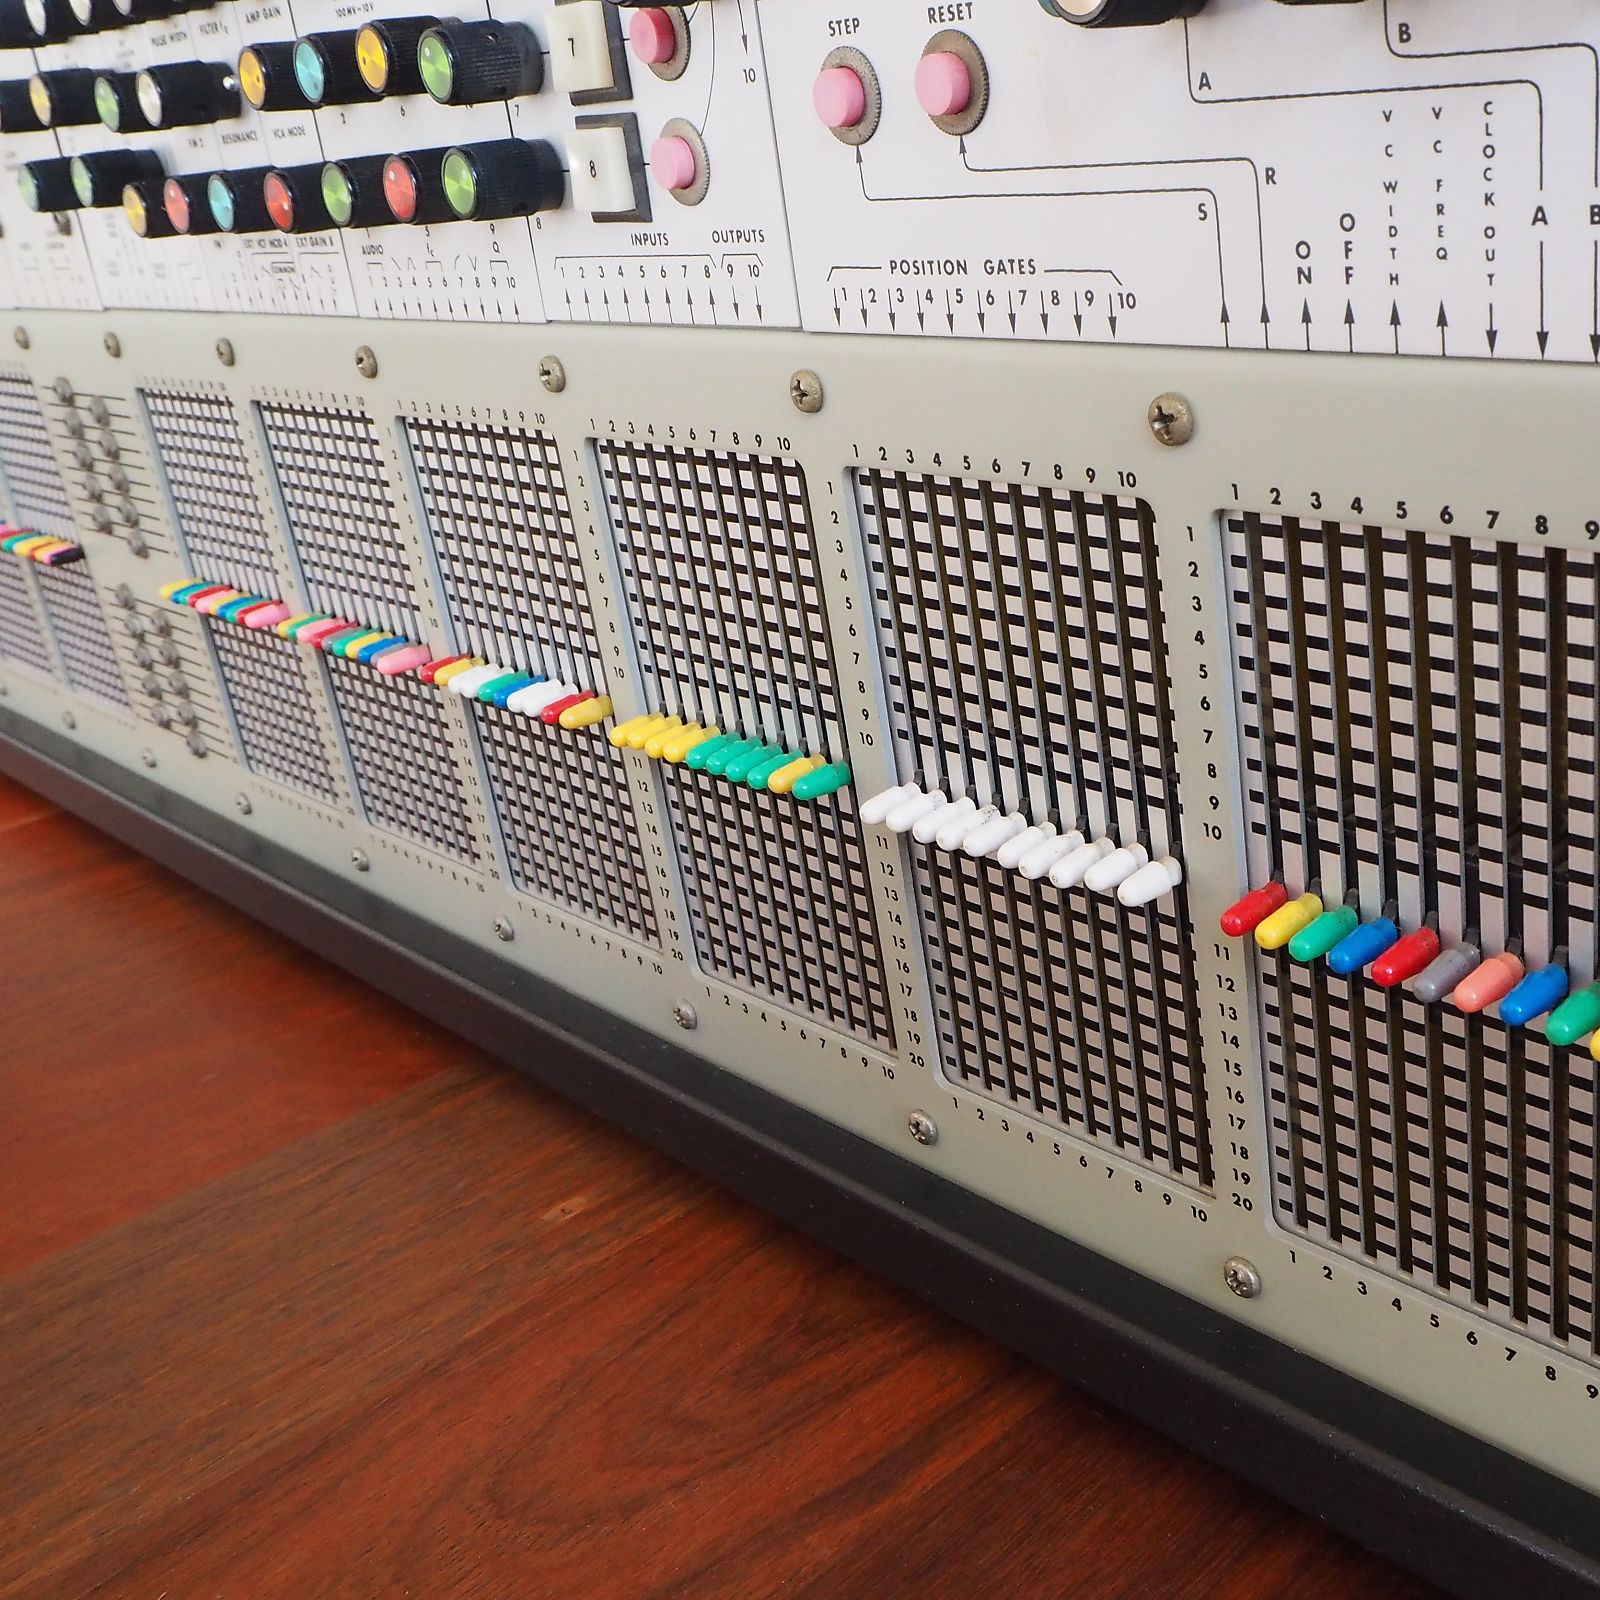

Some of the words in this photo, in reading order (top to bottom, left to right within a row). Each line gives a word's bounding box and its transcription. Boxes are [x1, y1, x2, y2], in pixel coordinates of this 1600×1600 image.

[262, 6, 281, 20] GAIN
[928, 2, 973, 24] RESET
[828, 17, 860, 37] STEP
[1398, 22, 1411, 43] B
[568, 37, 575, 57] 7
[743, 68, 756, 83] 10
[1198, 72, 1212, 91] A
[514, 104, 519, 117] 7
[589, 160, 597, 178] 8
[1265, 167, 1277, 185] R
[1198, 203, 1208, 221] S
[1531, 205, 1548, 226] A
[1590, 204, 1600, 225] B
[536, 217, 542, 230] 8
[631, 233, 669, 246] INPUTS
[712, 229, 765, 243] OUTPUTS
[361, 244, 383, 255] AUDIO
[492, 241, 500, 253] Q
[1339, 213, 1355, 285] OFF
[890, 259, 968, 276] POSITION
[984, 258, 1036, 275] GATES
[1295, 240, 1312, 285] ON
[560, 267, 565, 278] 1
[579, 266, 585, 278] 2
[598, 265, 605, 278] 3
[618, 265, 624, 277] 4
[640, 265, 645, 278] 5
[660, 265, 666, 278] 6
[681, 265, 687, 278] 7
[704, 265, 711, 279] 8
[727, 264, 733, 278] 9
[748, 264, 760, 278] 10
[842, 287, 847, 301] 1
[868, 288, 877, 303] 2
[896, 288, 904, 303] 3
[925, 289, 934, 304] 4
[956, 288, 963, 304] 5
[986, 290, 995, 306] 6
[1018, 290, 1027, 306] 7
[1051, 290, 1060, 306] 8
[1084, 290, 1094, 307] 9
[1117, 292, 1136, 309] 10
[590, 418, 595, 430] 1
[609, 420, 616, 432] 2
[628, 421, 635, 434] 3
[648, 424, 654, 436] 4
[669, 426, 675, 438] 5
[690, 428, 696, 440] 6
[710, 430, 716, 443] 7
[732, 432, 740, 445] 8
[755, 434, 762, 447] 9
[777, 437, 790, 451] 10
[853, 444, 859, 458] 1
[879, 446, 887, 461] 2
[906, 449, 914, 464] 3
[933, 452, 942, 467] 4
[963, 455, 971, 470] 5
[992, 458, 1001, 474] 6
[1022, 461, 1030, 476] 7
[1054, 464, 1063, 480] 8
[1086, 467, 1096, 483] 9
[1118, 471, 1136, 488] 10
[1231, 483, 1238, 500] 1
[1269, 487, 1281, 505] 2
[1310, 492, 1322, 510] 3
[1350, 497, 1363, 514] 4
[1396, 501, 1408, 519] 5
[1440, 505, 1454, 525] 6
[1486, 510, 1500, 529] 7
[1535, 515, 1549, 535] 8
[1585, 520, 1600, 540] 9
[1187, 526, 1193, 542] 1
[1188, 561, 1199, 578] 2
[1192, 596, 1202, 612] 3
[1194, 630, 1205, 646] 4
[1199, 664, 1208, 679] 5
[1200, 696, 1211, 711] 6
[1203, 729, 1213, 744] 7
[1207, 763, 1217, 778] 8
[1209, 795, 1219, 810] 9
[1203, 822, 1222, 840] 10
[876, 835, 888, 850] 11
[880, 862, 894, 877] 12
[884, 887, 898, 901] 13
[888, 910, 902, 926] 14
[892, 935, 906, 949] 15
[1214, 943, 1229, 961] 11
[896, 958, 910, 973] 16
[900, 983, 912, 997] 17
[1216, 974, 1235, 992] 12
[904, 1007, 917, 1022] 18
[1219, 1003, 1238, 1021] 13
[907, 1030, 920, 1044] 19
[1221, 1030, 1240, 1049] 14
[909, 1052, 924, 1067] 20
[1224, 1059, 1242, 1076] 15
[1226, 1086, 1245, 1104] 16
[1228, 1113, 1245, 1130] 17
[1230, 1142, 1249, 1160] 18
[1232, 1168, 1251, 1185] 19
[1232, 1193, 1253, 1211] 20
[1290, 1250, 1296, 1263] 1
[1323, 1265, 1333, 1280] 2
[1357, 1281, 1367, 1295] 3
[1391, 1298, 1402, 1312] 4
[1430, 1314, 1439, 1328] 5
[1466, 1331, 1478, 1345] 6
[1505, 1347, 1517, 1361] 7
[1545, 1366, 1556, 1381] 8
[1586, 1384, 1599, 1399] 9
